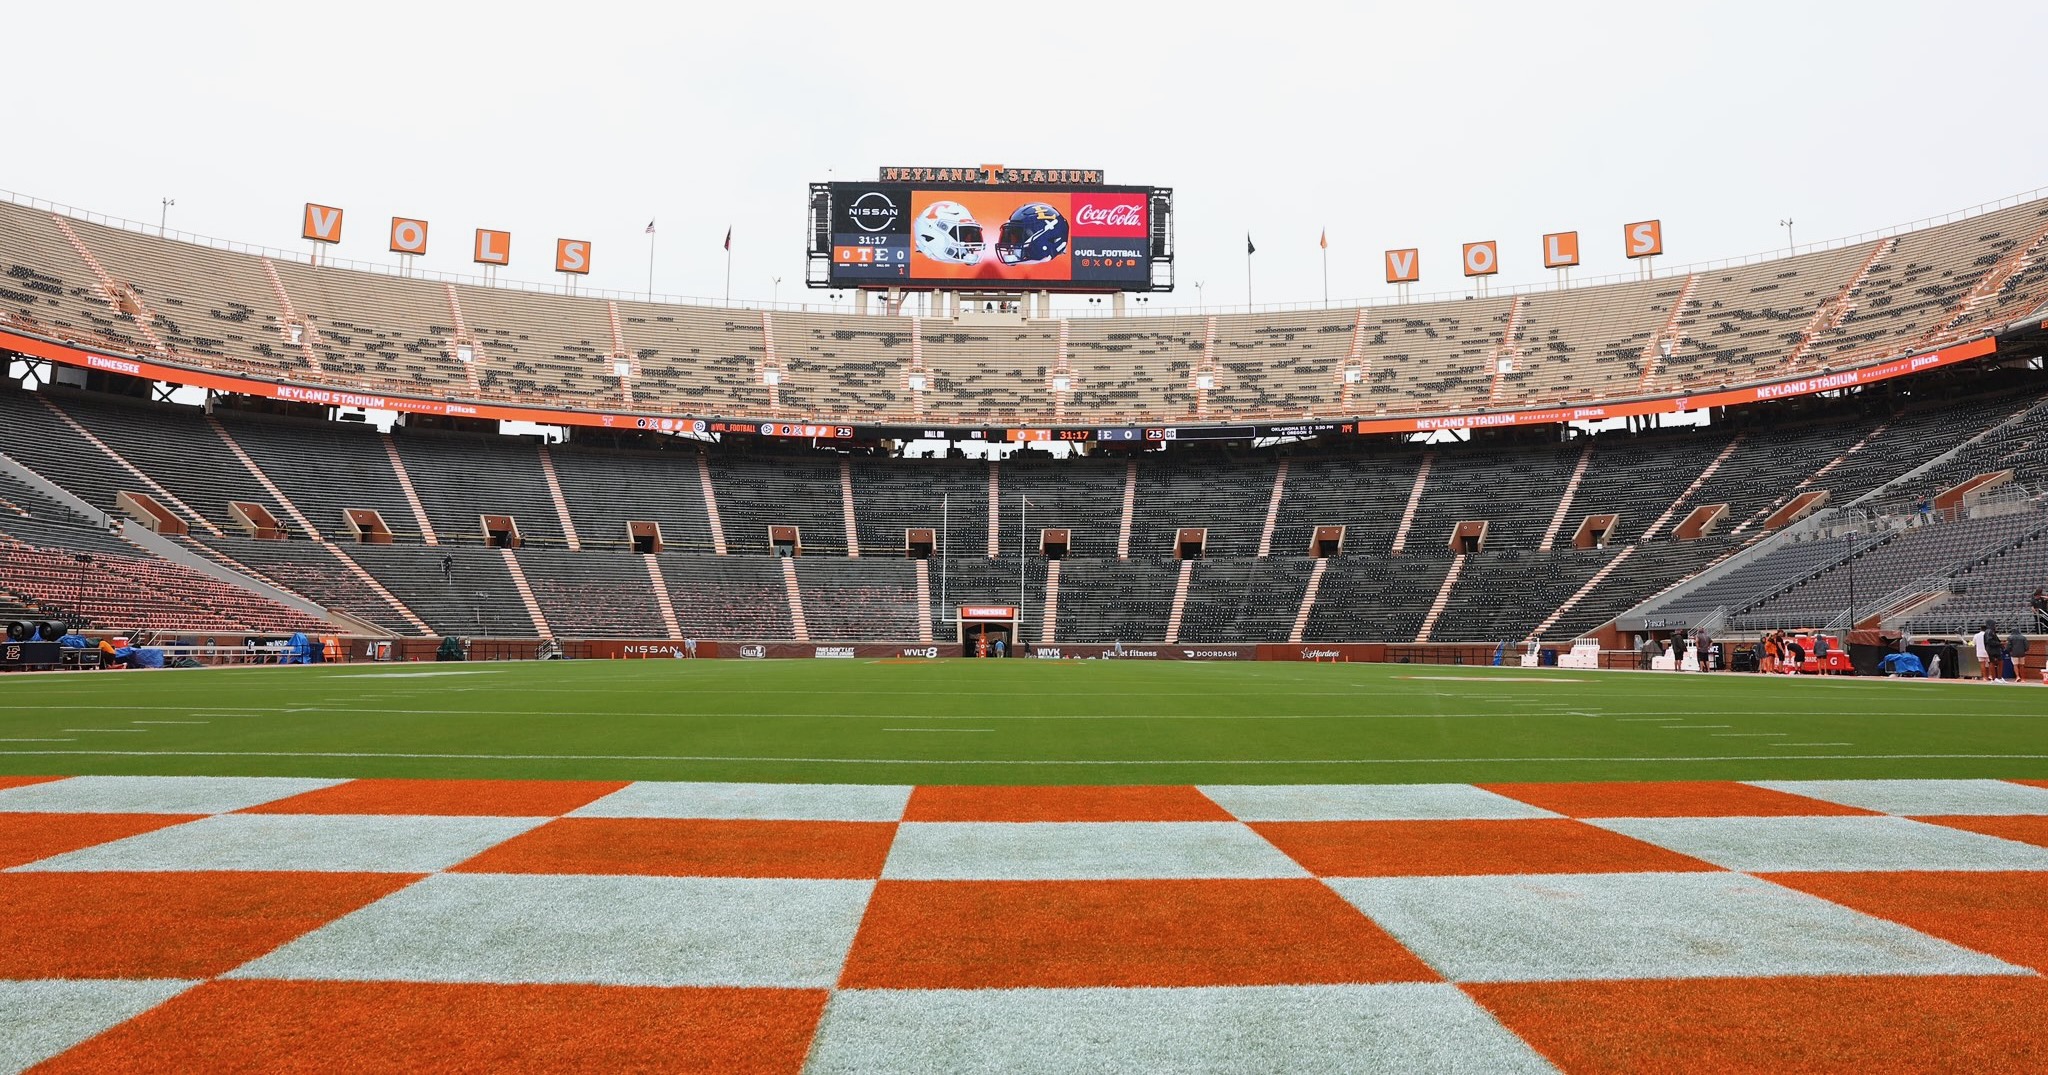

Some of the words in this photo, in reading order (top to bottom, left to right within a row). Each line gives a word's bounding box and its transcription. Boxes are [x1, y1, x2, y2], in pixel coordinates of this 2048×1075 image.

[886, 168, 975, 181] NEYLAND
[980, 164, 1004, 184] T
[1008, 169, 1097, 183] STADIUM
[849, 208, 898, 216] NISSAN
[1076, 204, 1143, 226] Coca-Cola
[858, 236, 887, 244] 31:17
[87, 356, 140, 373] TENNESSEE
[1757, 382, 1807, 398] NEYLAND
[1809, 373, 1858, 389] STADIUM
[277, 386, 330, 401] NEYLAND
[332, 393, 385, 407] STADIUM
[1417, 417, 1464, 428] NEYLAND
[1467, 414, 1515, 425] STADIUM
[710, 422, 756, 433] @VOL_FOOTBALL
[837, 428, 851, 436] 25
[1059, 431, 1089, 440] 31:17
[1148, 430, 1162, 438] 25
[624, 645, 679, 653] NISSAN
[1037, 648, 1060, 656] WIVK
[1102, 649, 1127, 659] plaet
[1129, 649, 1158, 657] fitness
[1829, 657, 1838, 666] G
